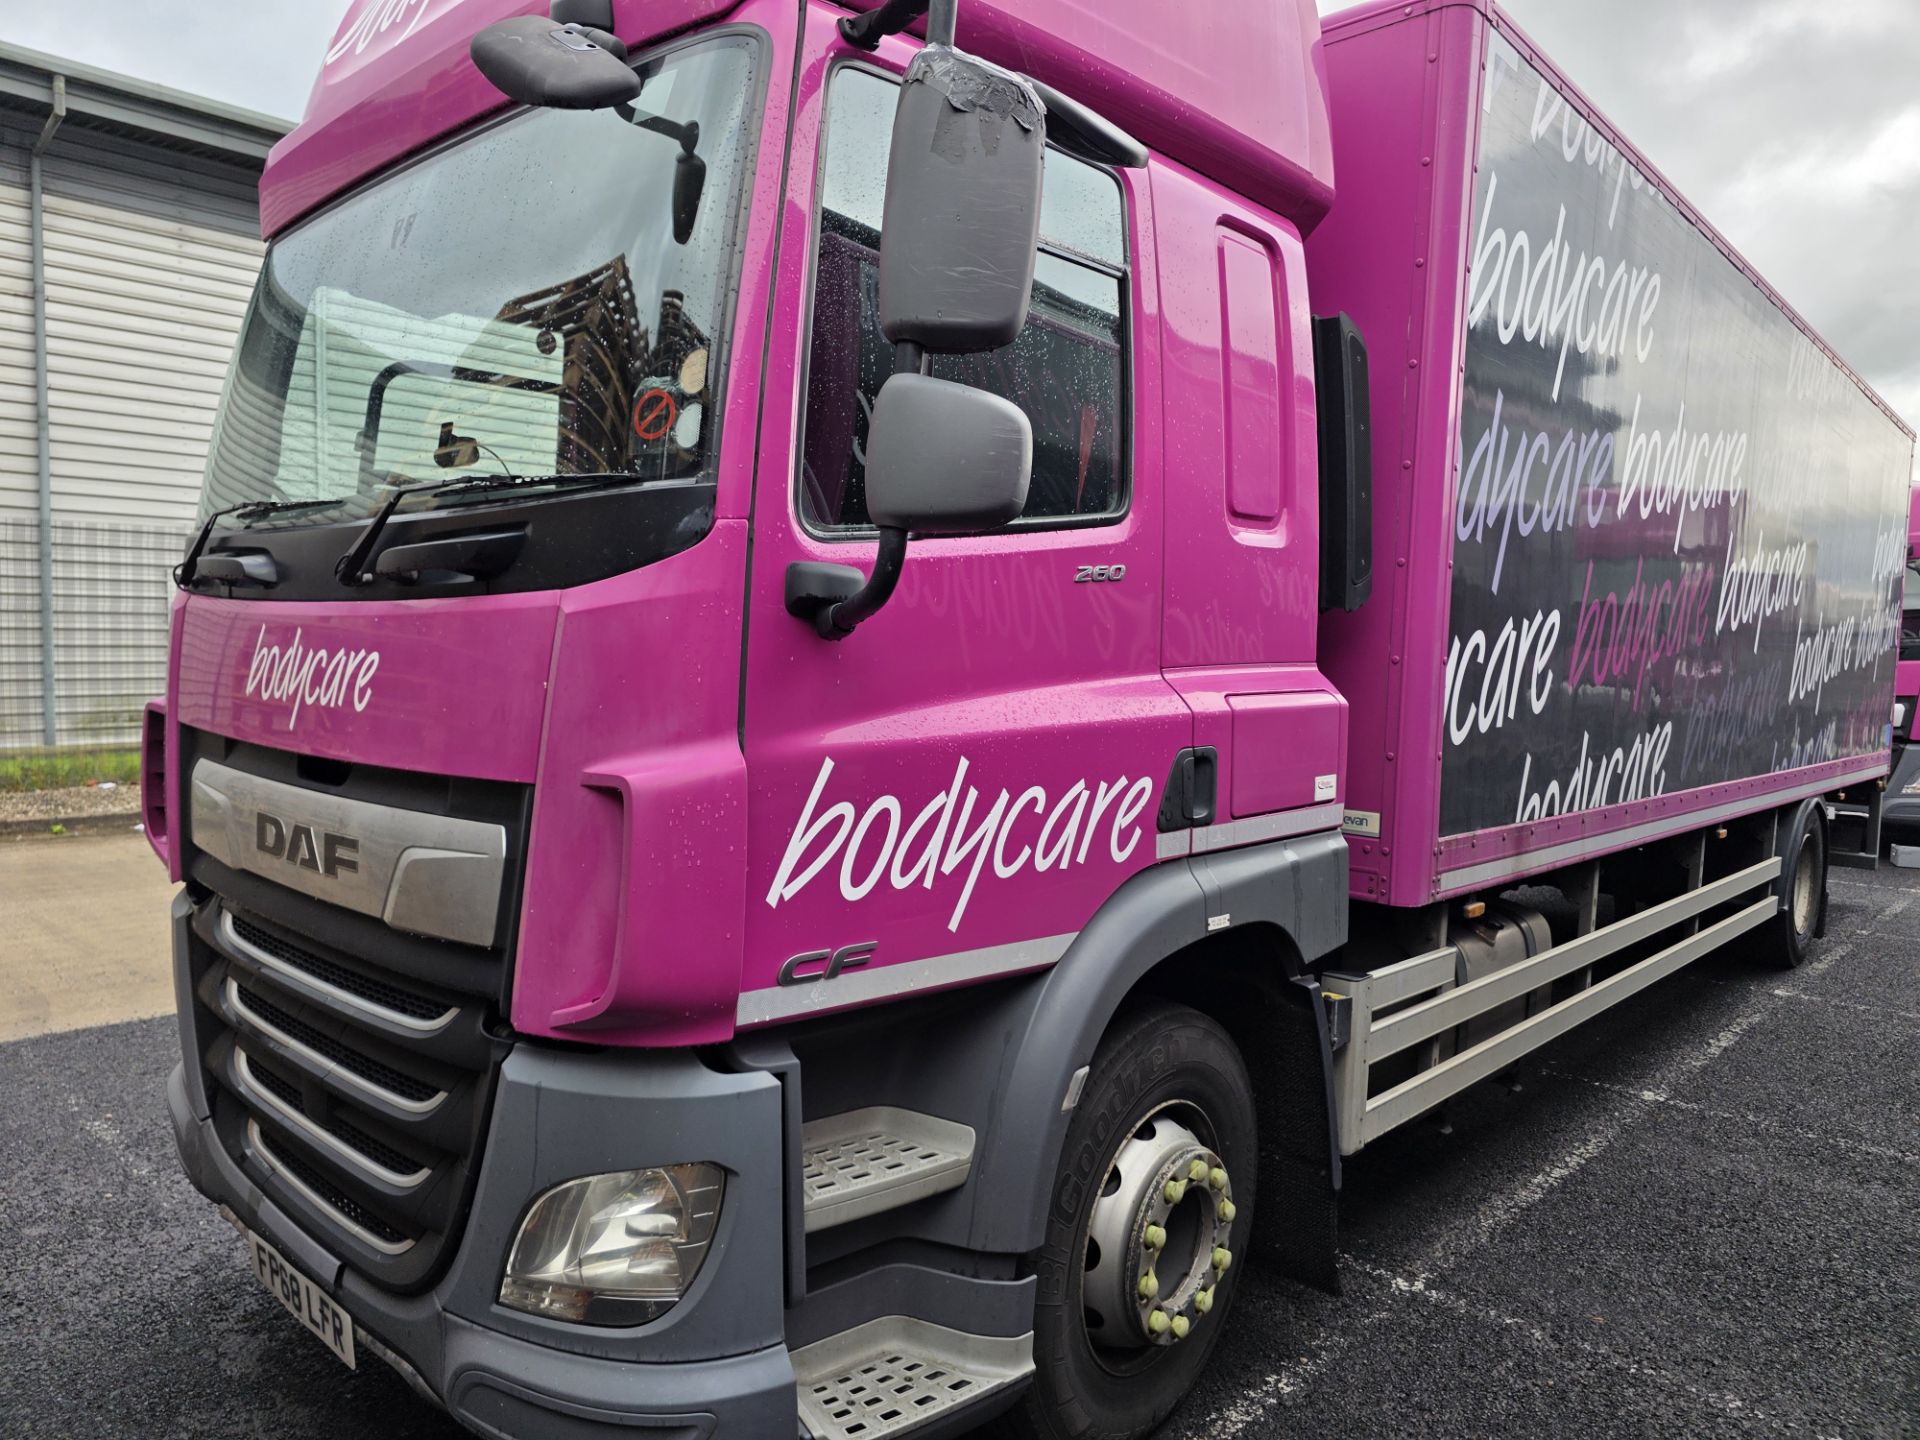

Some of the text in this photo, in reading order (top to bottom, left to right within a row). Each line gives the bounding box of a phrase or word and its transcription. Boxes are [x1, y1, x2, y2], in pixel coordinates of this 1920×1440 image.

[1468, 170, 1661, 403] bodycare
[1456, 388, 1614, 596] dycare
[1617, 392, 1748, 555] bodycare
[1073, 565, 1126, 583] 260
[1567, 554, 1714, 713] bodycare
[1715, 528, 1807, 655] bodycare
[246, 623, 380, 732] bodycare
[1788, 611, 1855, 716] bodycare
[256, 811, 360, 880] DAF
[765, 755, 1153, 933] bodycare
[777, 940, 879, 987] CF
[255, 1241, 345, 1355] FP68 LFR
